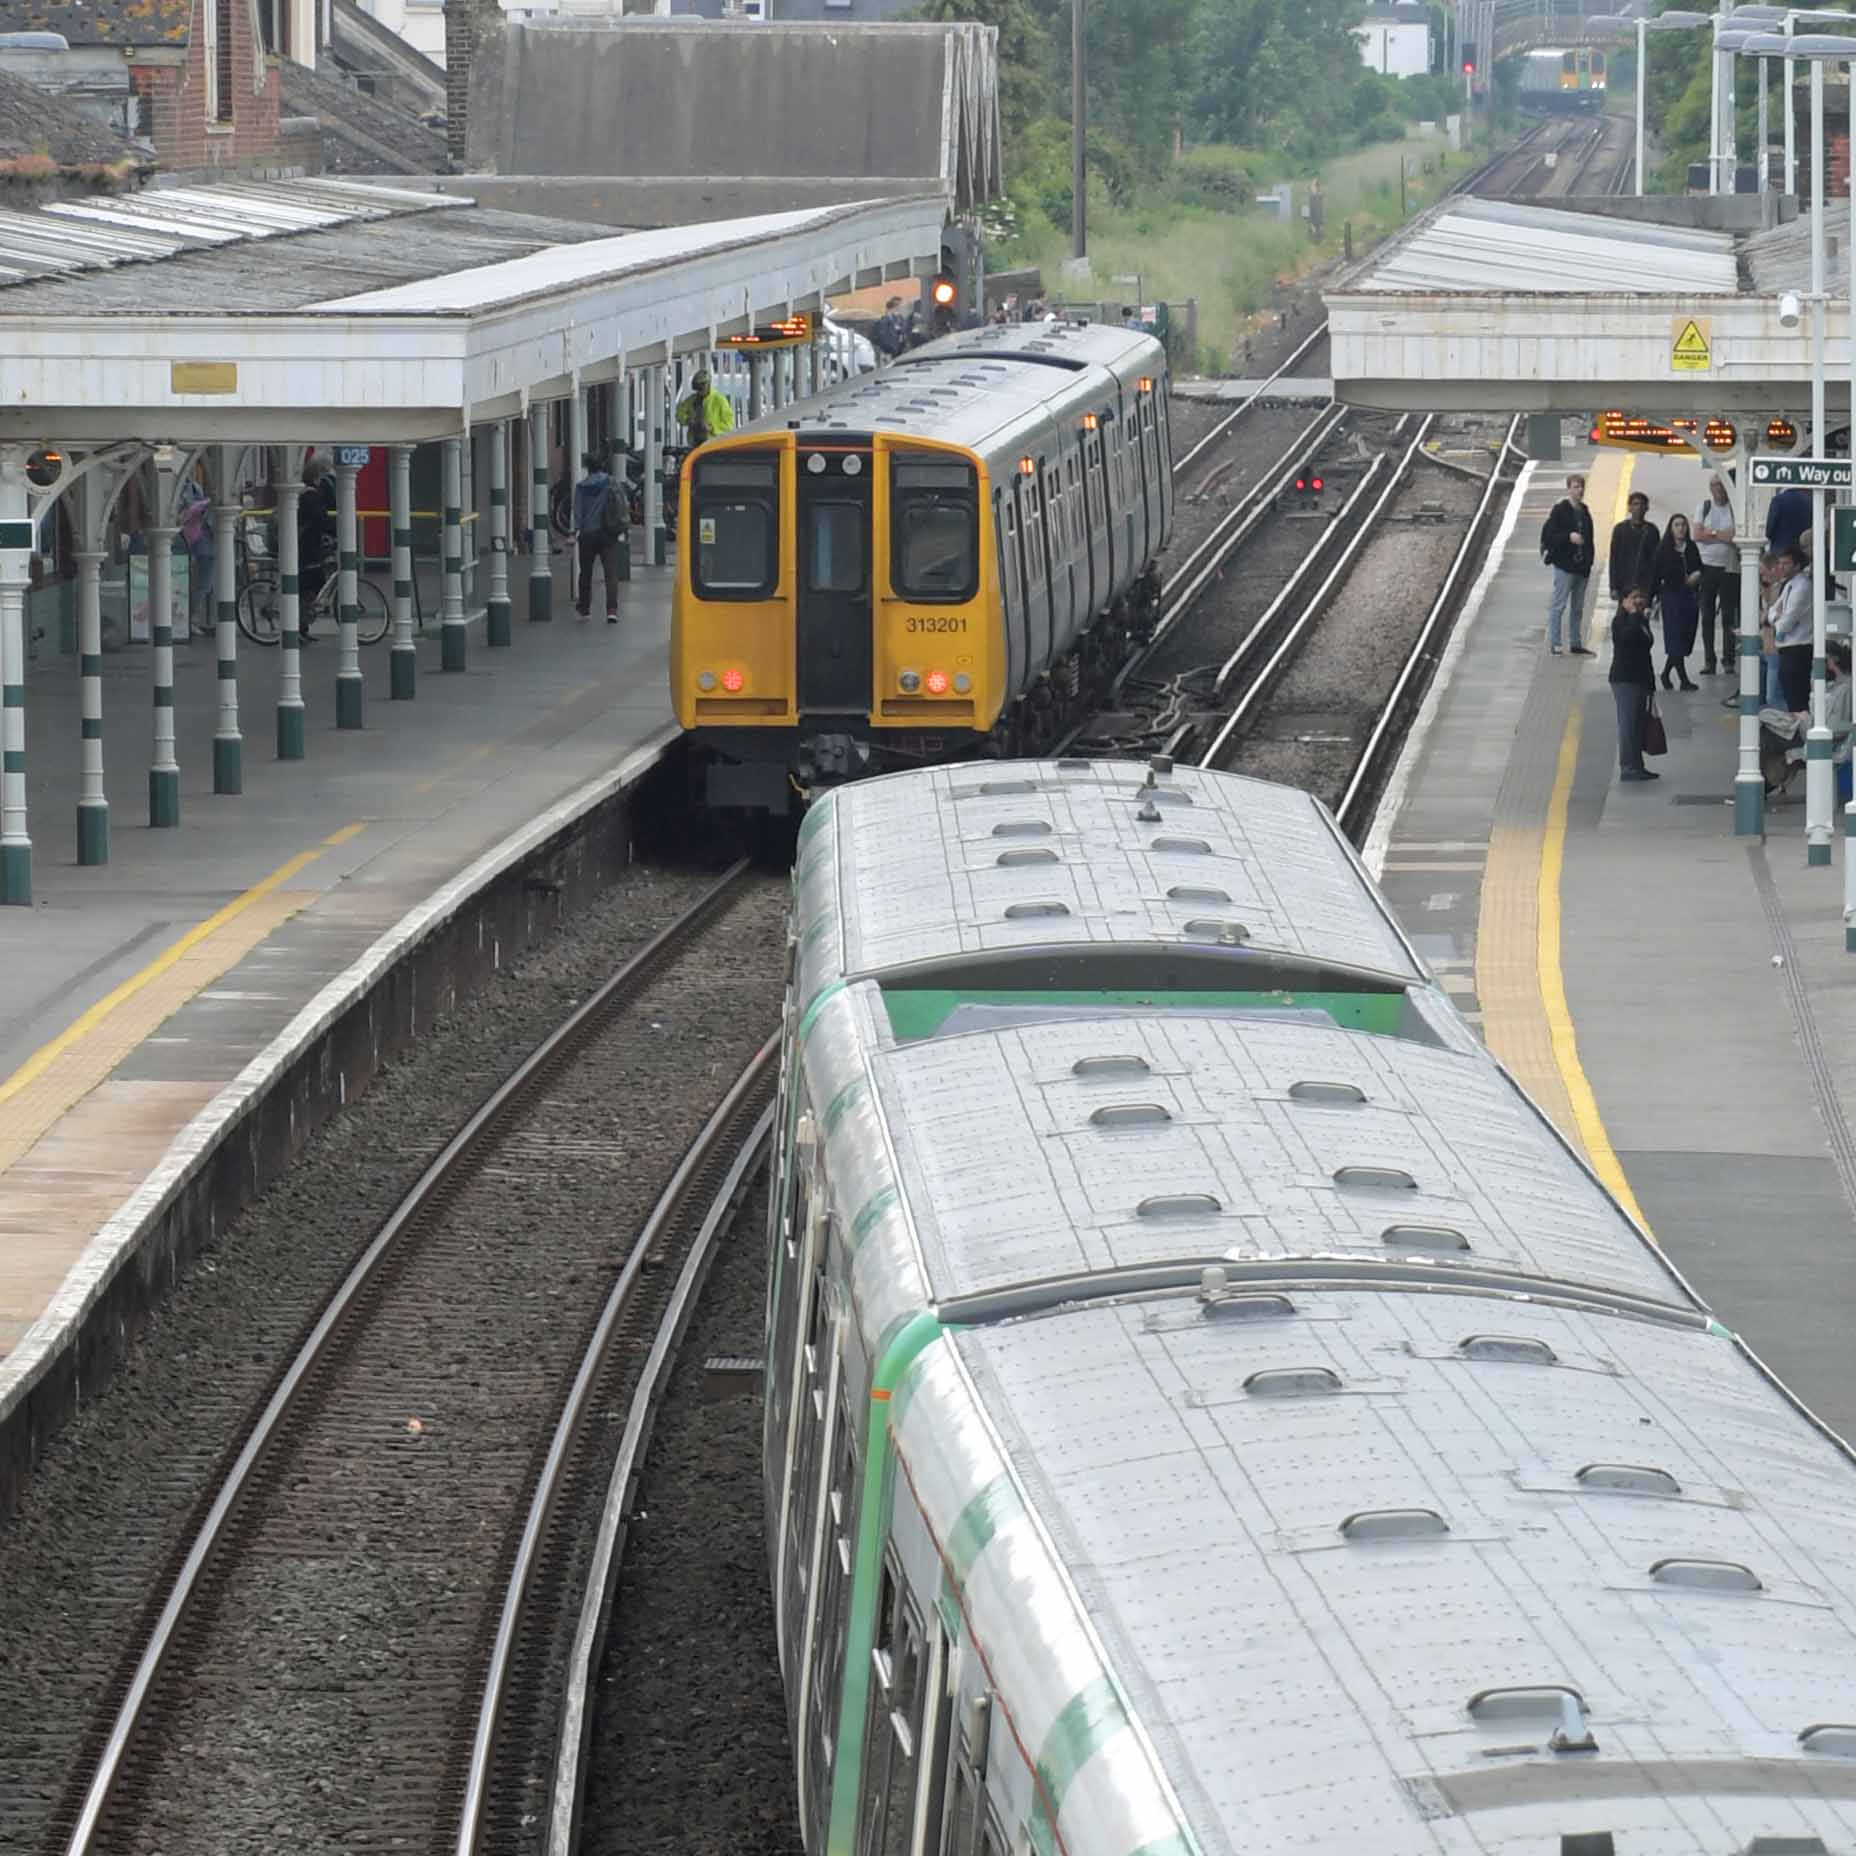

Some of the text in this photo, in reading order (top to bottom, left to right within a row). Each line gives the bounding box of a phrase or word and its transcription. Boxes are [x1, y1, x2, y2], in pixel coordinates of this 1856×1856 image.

[1798, 465, 1852, 484] Way ou
[906, 617, 967, 633] 313201
